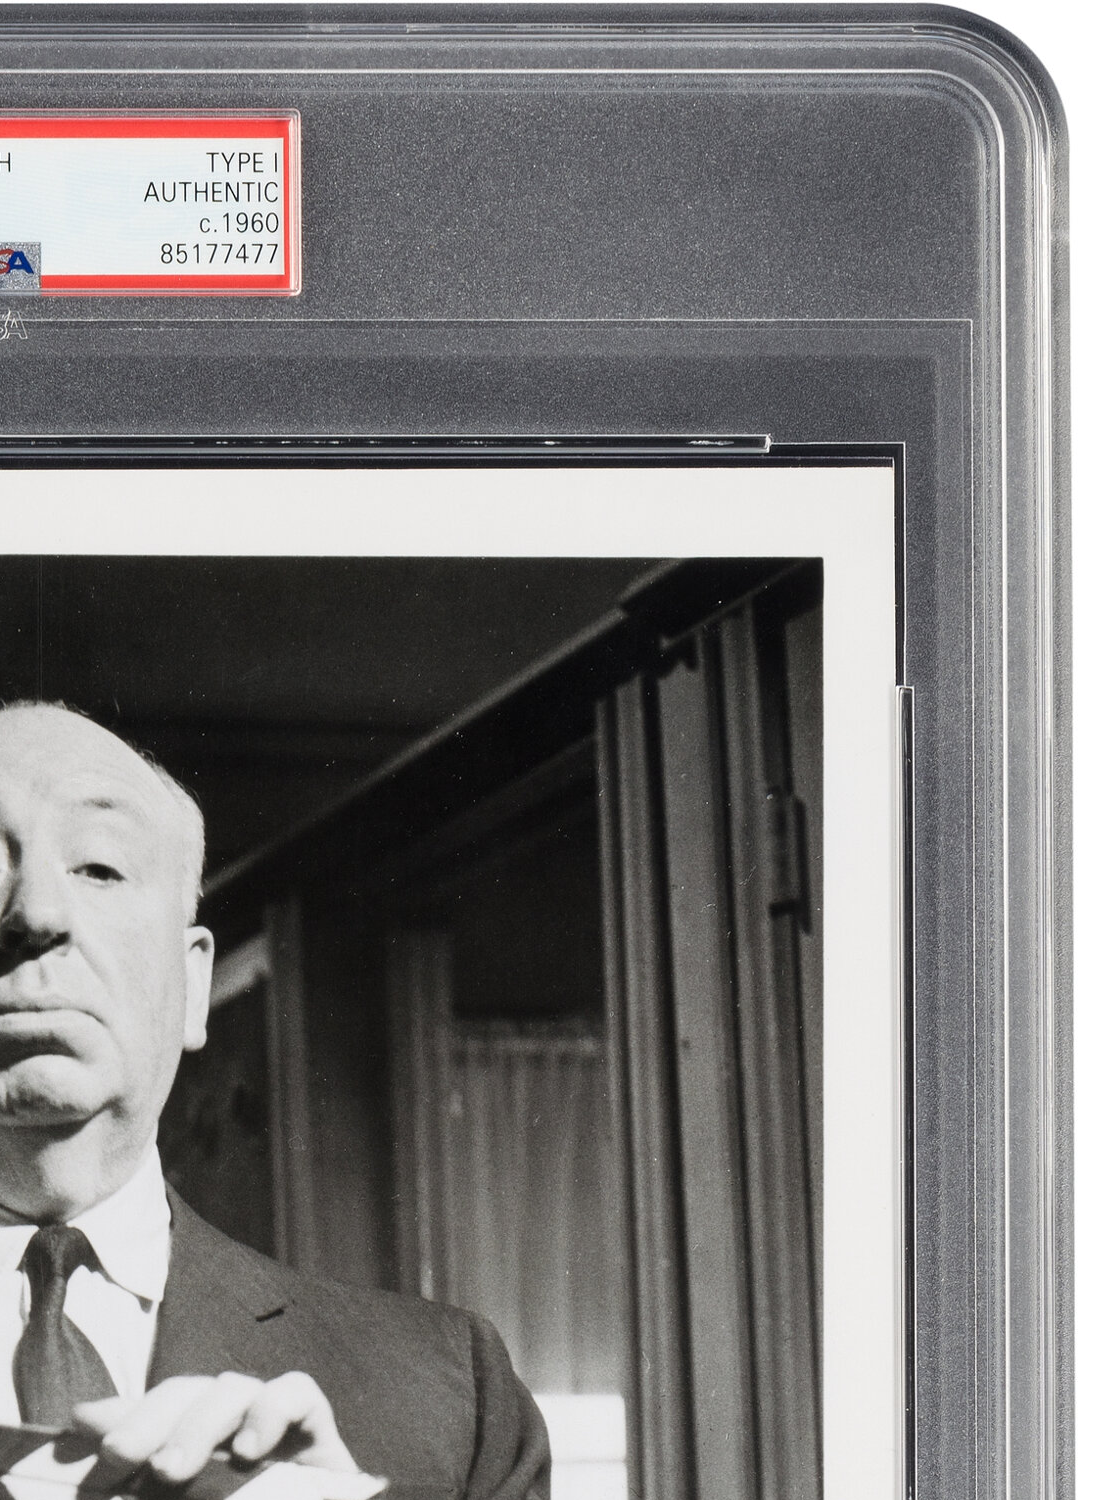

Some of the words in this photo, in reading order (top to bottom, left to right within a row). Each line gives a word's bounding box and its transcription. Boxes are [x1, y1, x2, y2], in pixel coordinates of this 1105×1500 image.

[205, 151, 264, 174] TYPE
[143, 181, 280, 204] AUTHENTIC
[199, 211, 280, 235] c.1960
[160, 243, 280, 265] 85177477
